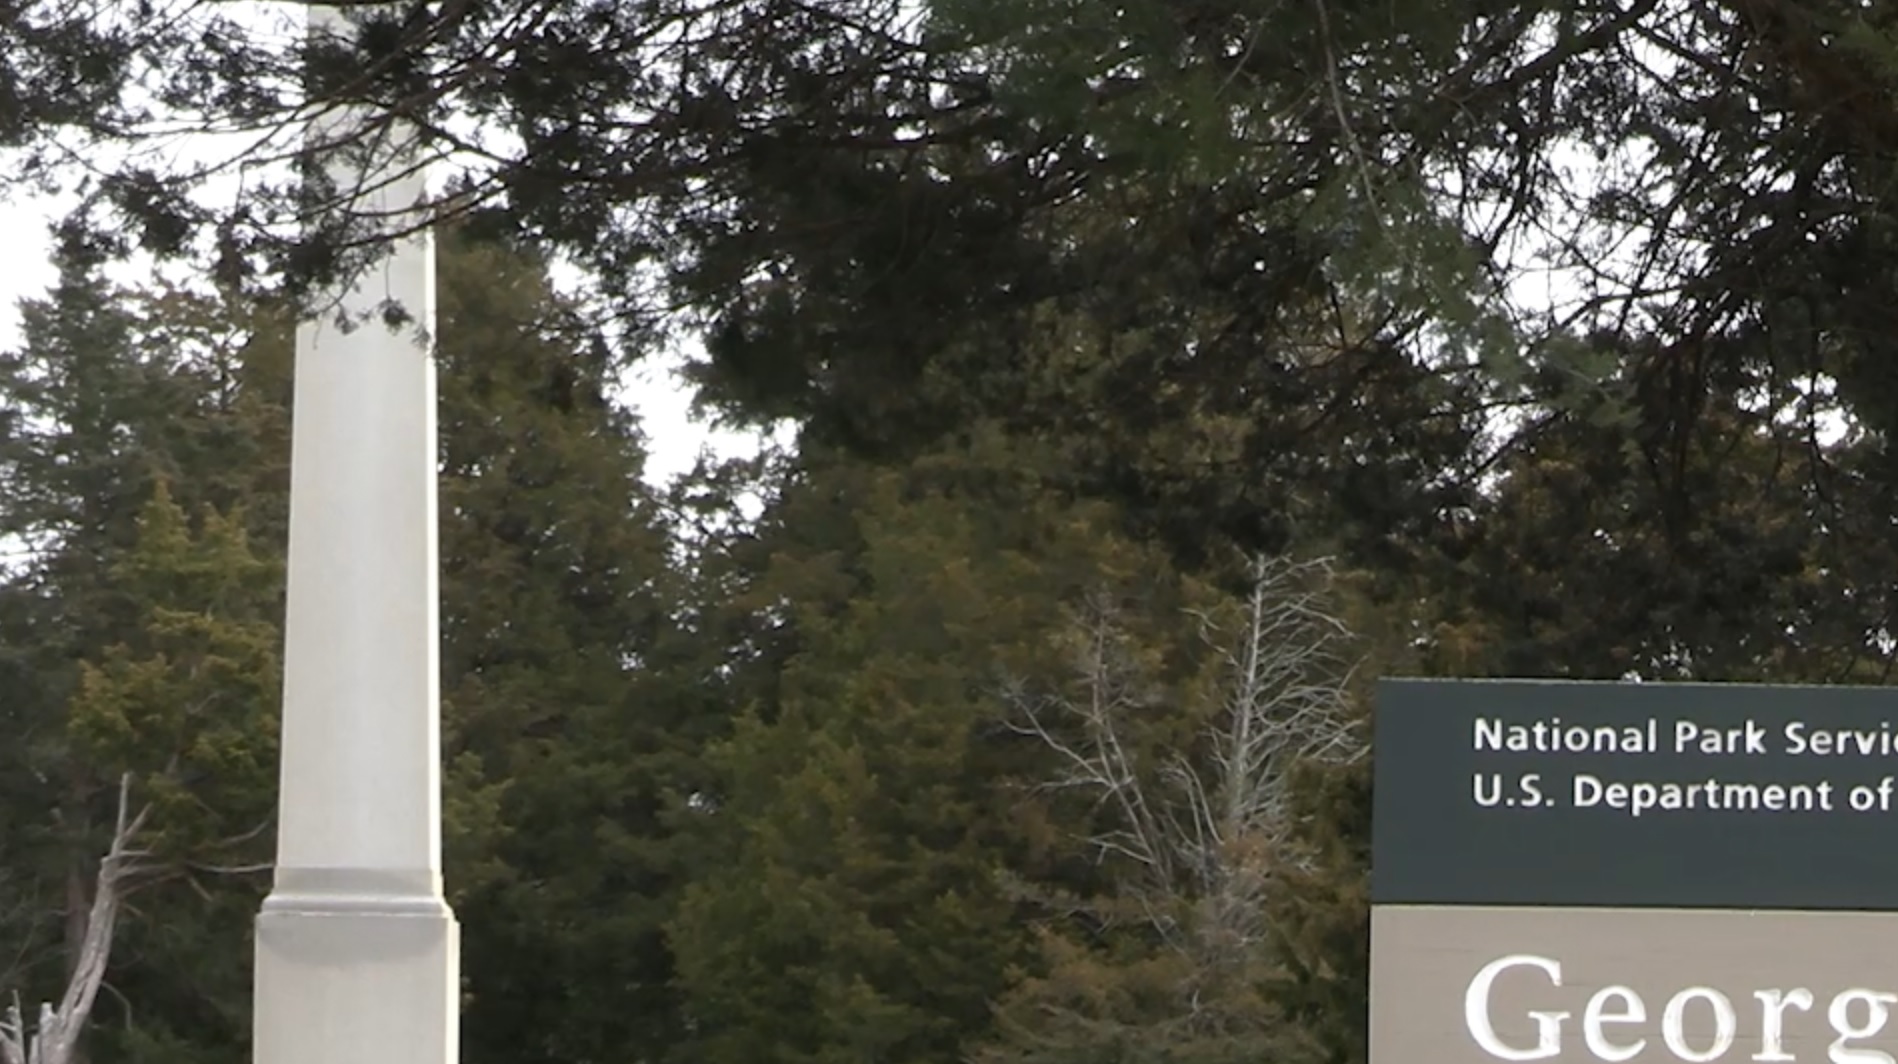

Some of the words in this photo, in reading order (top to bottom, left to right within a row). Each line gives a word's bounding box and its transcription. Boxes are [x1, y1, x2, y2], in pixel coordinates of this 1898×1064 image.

[1474, 717, 1657, 753] National
[1675, 719, 1767, 754] Park
[1474, 773, 1555, 807] U.S.
[1574, 775, 1833, 817] Department
[1849, 776, 1894, 811] of
